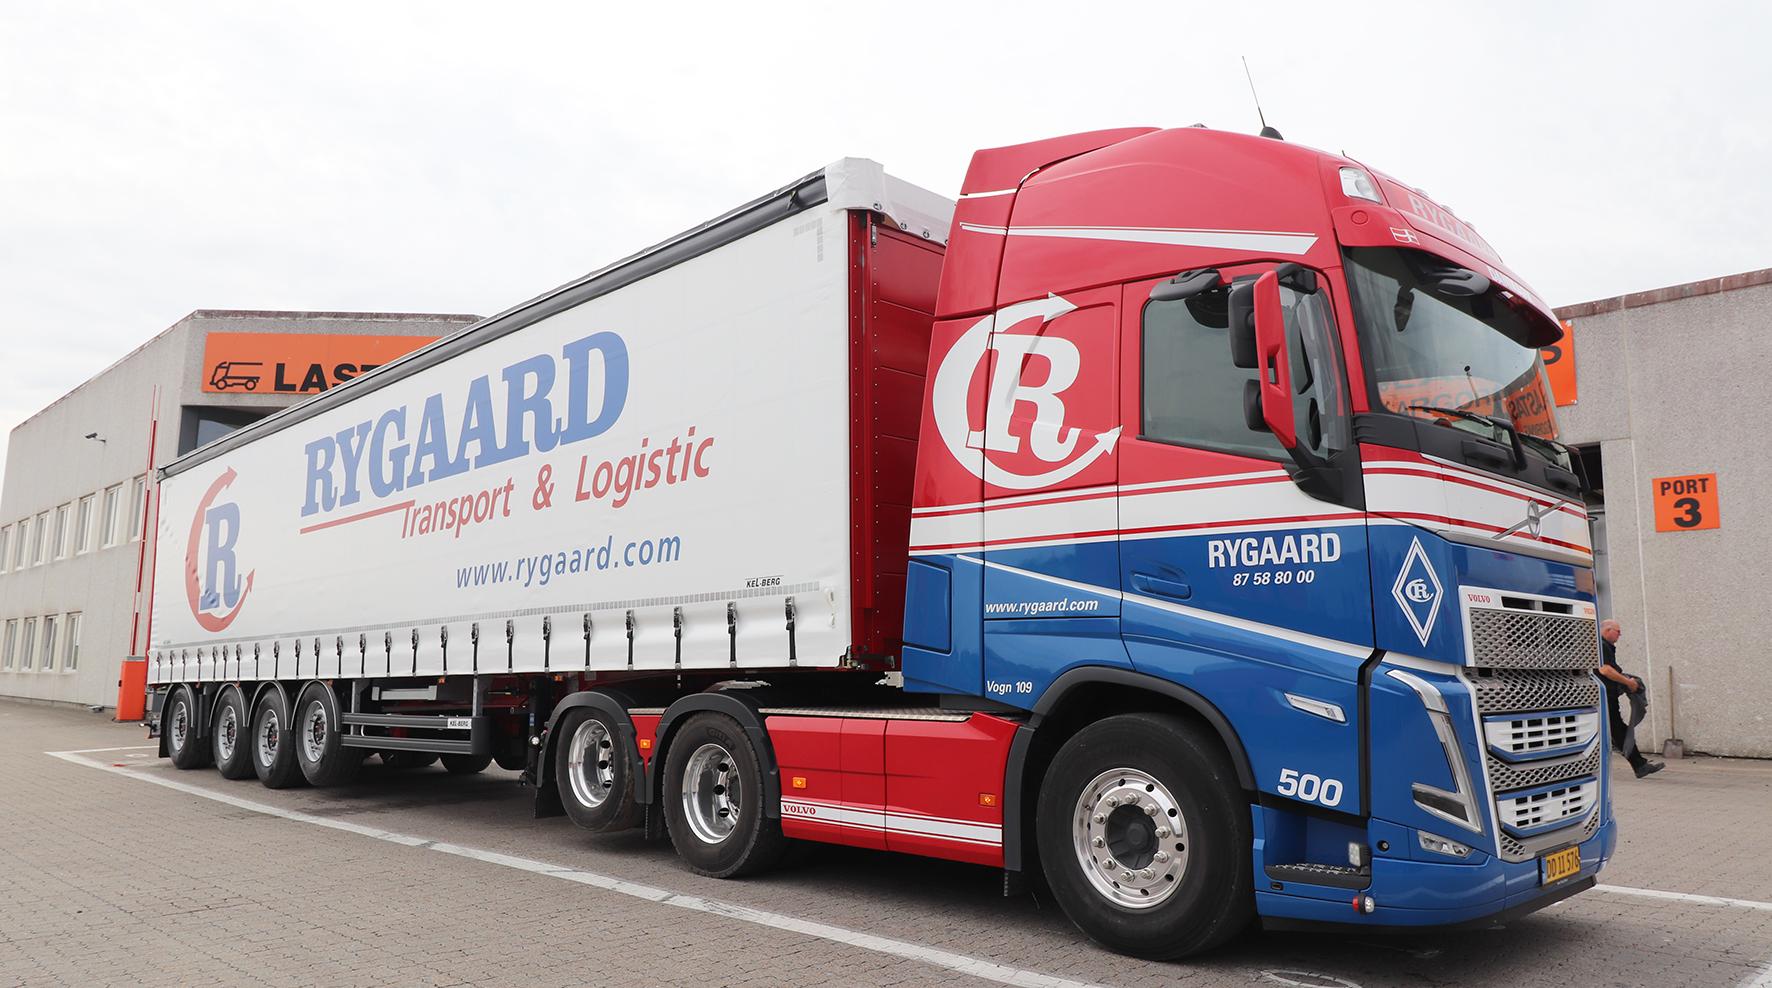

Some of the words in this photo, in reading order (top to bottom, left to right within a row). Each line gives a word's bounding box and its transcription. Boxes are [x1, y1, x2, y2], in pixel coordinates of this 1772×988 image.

[274, 362, 383, 392] LAS
[300, 330, 630, 518] RYGAARD
[401, 477, 514, 539] Transport
[532, 463, 555, 511] &
[575, 426, 714, 508] Logistic
[1660, 478, 1709, 496] PORT
[1673, 497, 1702, 528] 3
[456, 535, 681, 589] www.rygaard.com
[1208, 533, 1341, 568] RYGAARD
[746, 577, 781, 588] KEL-BERG
[1233, 573, 1249, 586] 87
[1253, 572, 1271, 585] 58
[1274, 571, 1292, 584] 80
[1296, 570, 1315, 584] 00
[985, 598, 1099, 615] www.rygaard.com
[1468, 594, 1491, 604] VOLVO
[986, 681, 1012, 695] Vogn
[1016, 681, 1033, 694] 109
[1277, 768, 1343, 807] 500
[783, 804, 817, 815] VOLVO
